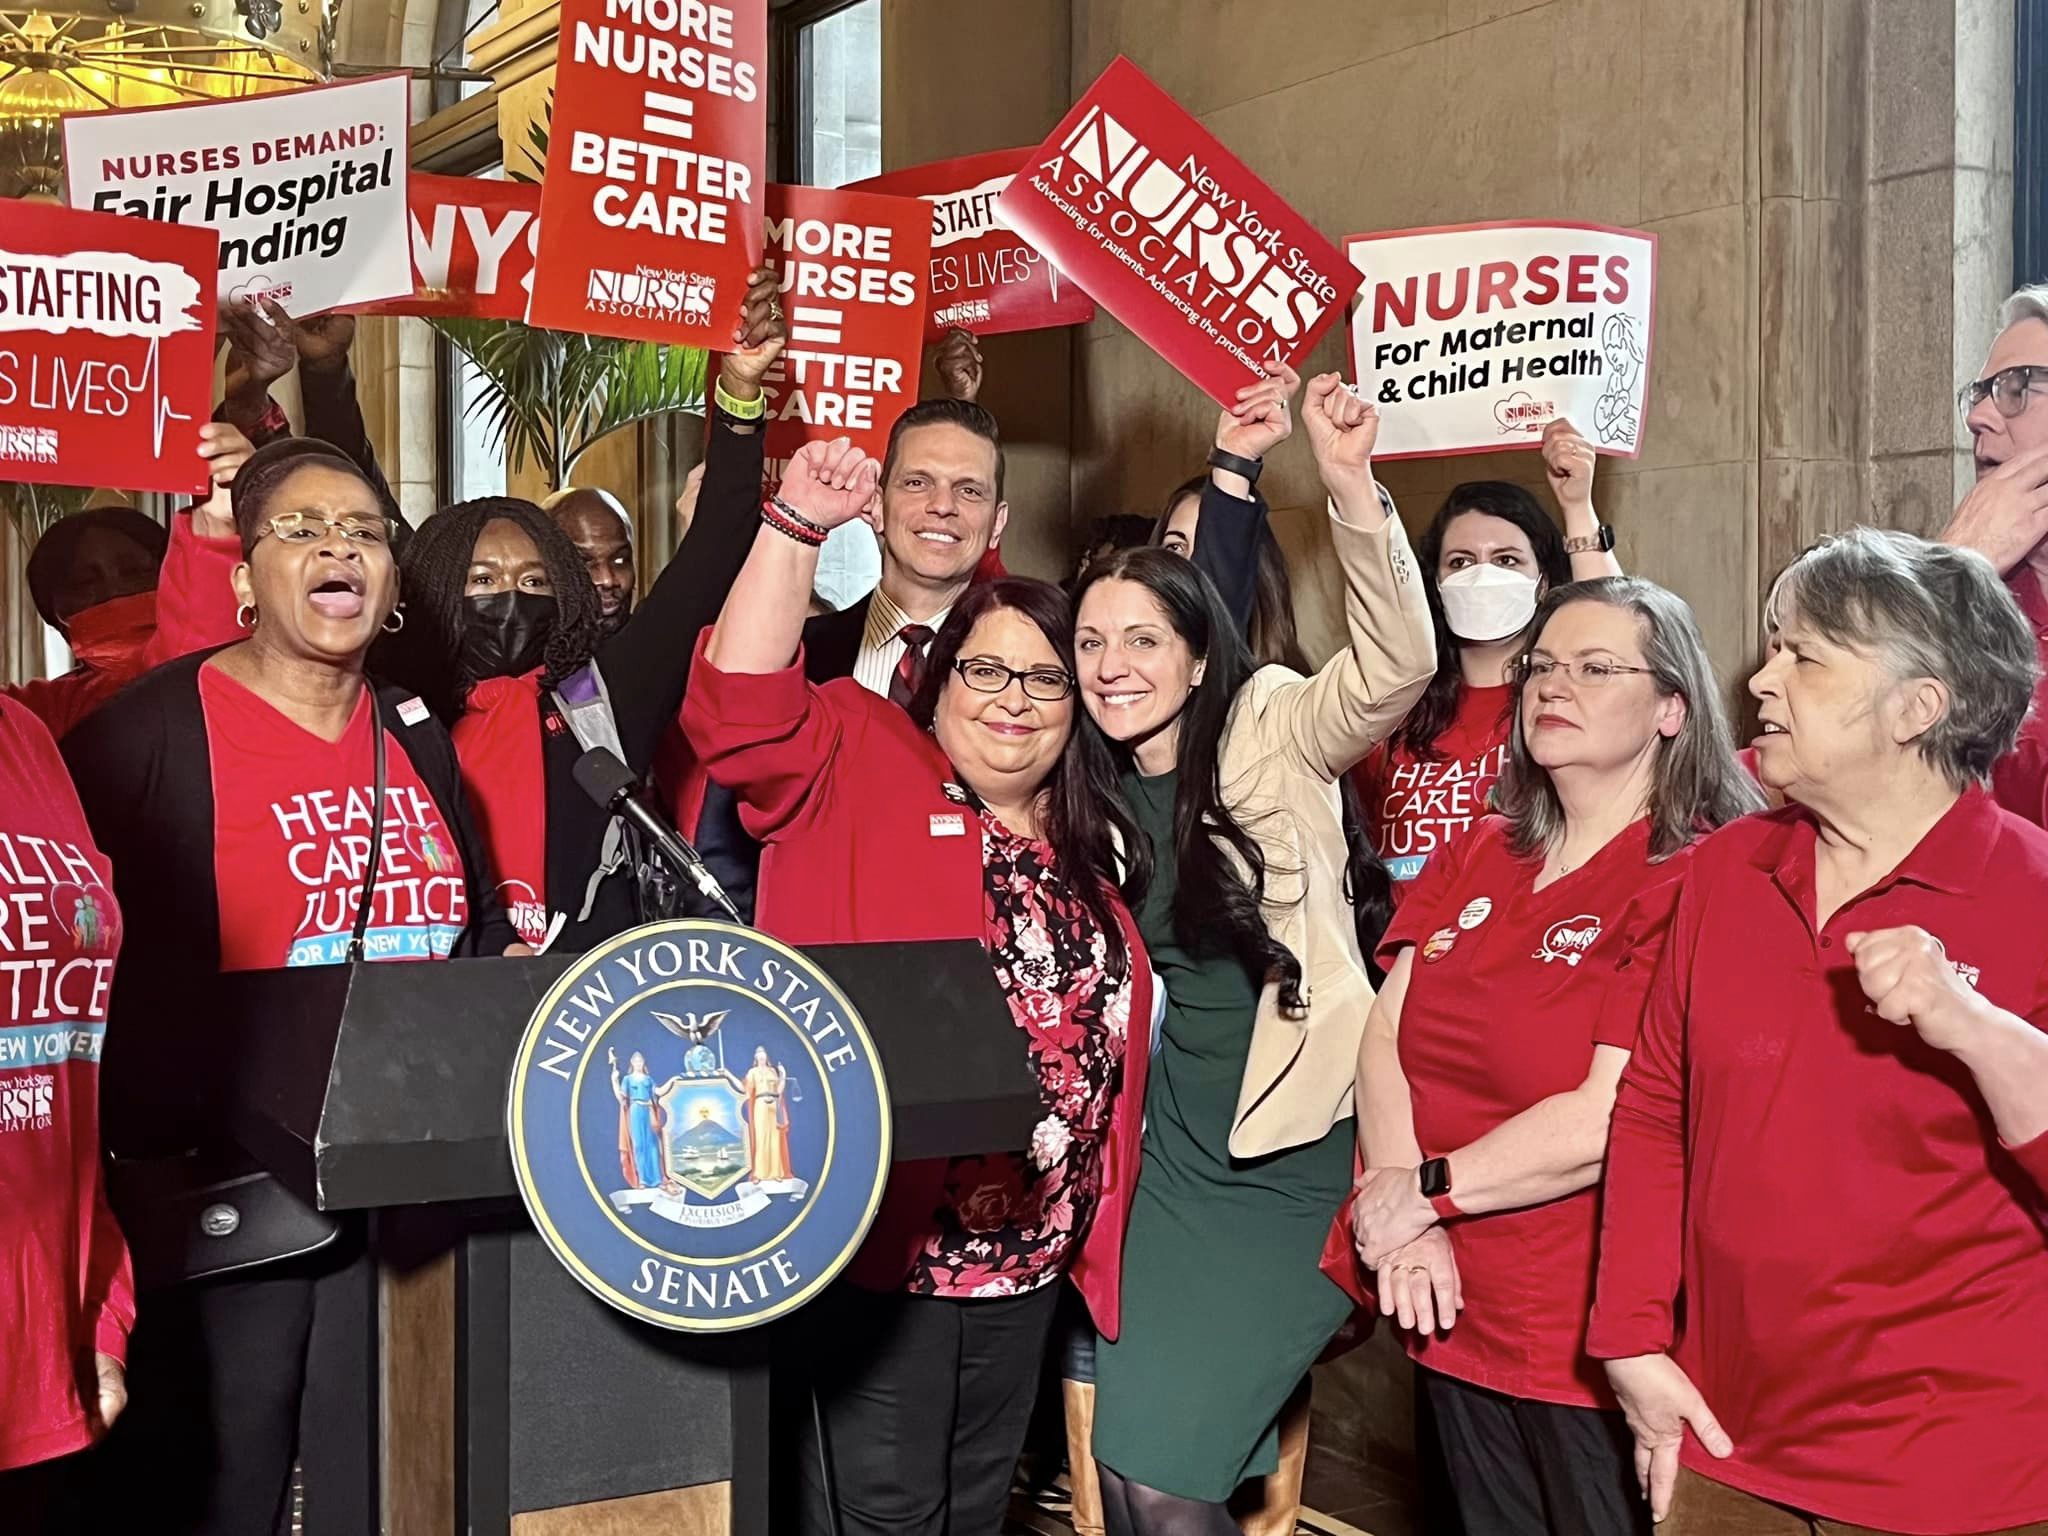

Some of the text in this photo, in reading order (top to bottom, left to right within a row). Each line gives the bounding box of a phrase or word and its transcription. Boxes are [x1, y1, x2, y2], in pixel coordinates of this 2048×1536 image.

[574, 21, 757, 103] NURSES
[101, 122, 385, 182] NURSES DEMAND:
[570, 130, 751, 204] BETTER
[92, 148, 393, 225] Fair Hospital
[592, 184, 728, 244] CARE
[217, 215, 348, 270] nding
[764, 216, 892, 262] MORE
[1060, 104, 1326, 349] NURSES
[1178, 153, 1337, 304] New York State
[635, 263, 716, 288] New York State
[764, 258, 916, 306] URSES
[965, 247, 1031, 288] LIVES
[1028, 175, 1088, 231] Advocating
[1086, 222, 1106, 241] for
[1145, 273, 1201, 325] Advancing
[1199, 317, 1219, 338] the
[1039, 155, 1291, 363] ASSOCIATION
[584, 298, 713, 328] ASSOCIATION
[587, 268, 716, 314] NURSES
[934, 302, 991, 325] NURSES
[1372, 254, 1630, 333] NURSES
[1374, 311, 1595, 370] For Maternal
[30, 353, 129, 416] LIVES
[761, 349, 903, 393] ETTER
[1377, 349, 1603, 404] & Child Health
[1382, 781, 1472, 819] CARE
[288, 832, 412, 887] CARE
[294, 877, 466, 938] JUSTICE
[537, 939, 857, 1080] NEW YORK STATE
[681, 1203, 744, 1218] EXCELSIOR
[631, 1248, 801, 1308] SENATE
